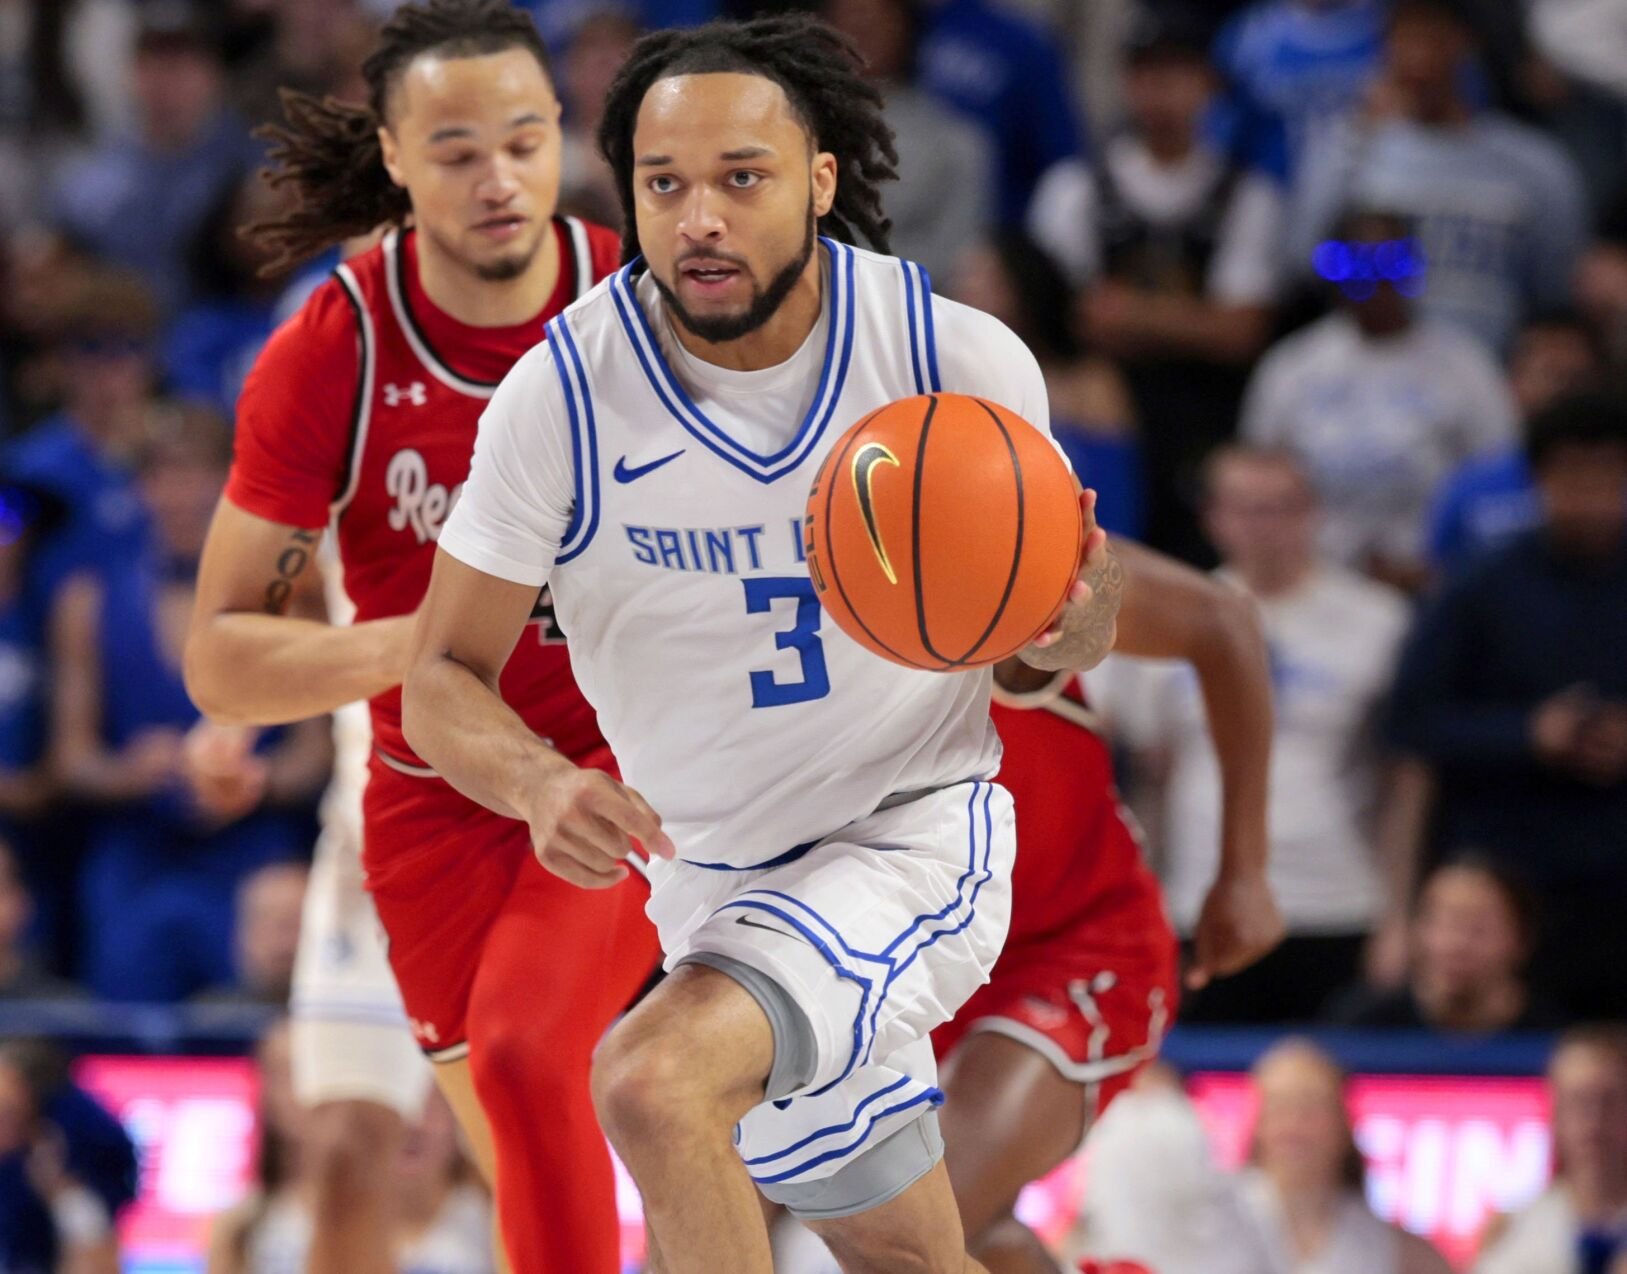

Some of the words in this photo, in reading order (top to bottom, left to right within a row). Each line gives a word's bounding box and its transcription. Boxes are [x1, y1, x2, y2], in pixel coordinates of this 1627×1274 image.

[386, 449, 464, 545] Re
[621, 523, 765, 575] SAINT
[740, 577, 831, 708] 3
